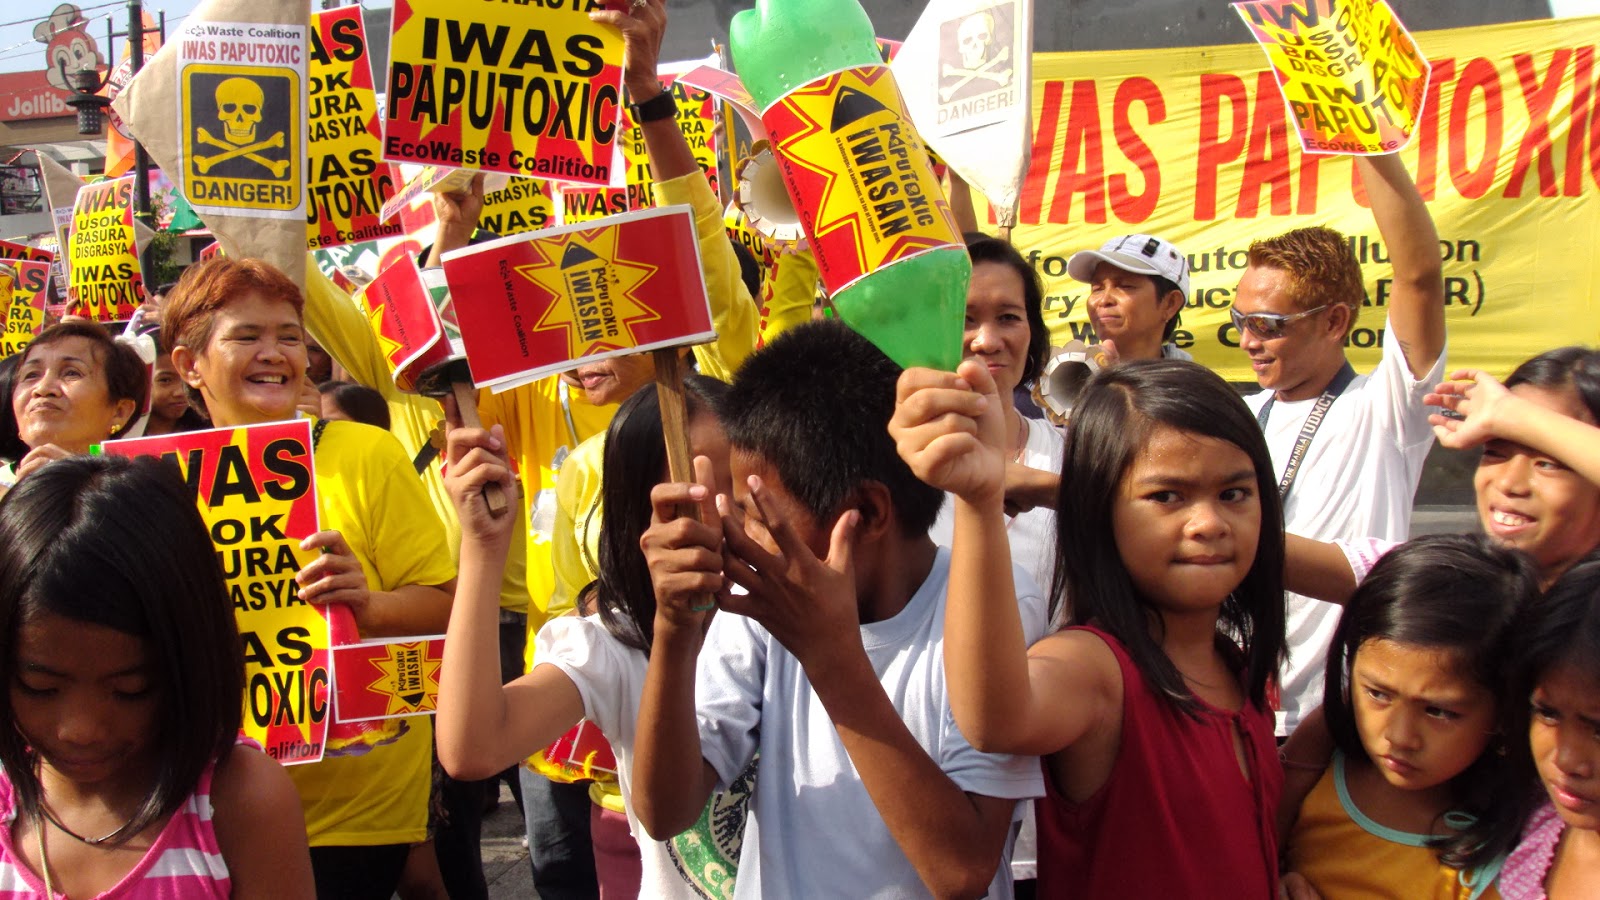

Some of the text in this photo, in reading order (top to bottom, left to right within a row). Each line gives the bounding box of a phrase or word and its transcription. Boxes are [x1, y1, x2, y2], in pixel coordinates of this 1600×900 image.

[1245, 0, 1337, 29] IW
[1277, 5, 1352, 46] USO
[207, 26, 243, 37] Waste
[248, 28, 300, 39] Coalition
[311, 18, 364, 66] AS
[422, 17, 604, 77] IWAS
[182, 41, 301, 64] IWAS PAPUTOXIC
[310, 71, 352, 95] OK
[8, 91, 77, 116] Jollib
[309, 92, 363, 119] URA
[388, 62, 618, 145] PAPUTOXIC
[937, 91, 1013, 124] DANGER!
[307, 149, 376, 184] AS
[386, 136, 608, 180] EcoWaste Coalition
[192, 180, 292, 204] DANGER!
[483, 182, 541, 206] GRASYA
[846, 127, 913, 239] IWASAN
[75, 183, 132, 216] IWAS
[307, 175, 394, 225] UTOXIC
[564, 191, 628, 217] IWAS
[80, 215, 122, 230] USOK
[336, 223, 401, 242] Coalition
[477, 205, 548, 233] WAS
[76, 228, 127, 244] BASURA
[76, 242, 129, 259] DISGRASYA
[76, 263, 134, 283] IWAS
[1026, 249, 1068, 277] fo
[504, 278, 518, 311] Waste
[514, 314, 530, 358] Coalition
[570, 269, 604, 342] IWASAN
[1303, 390, 1336, 434] UDMCT
[211, 514, 287, 545] OK
[222, 544, 301, 580] URA
[242, 626, 313, 668] AS
[408, 649, 419, 691] IWASAN
[269, 741, 320, 760] alition
